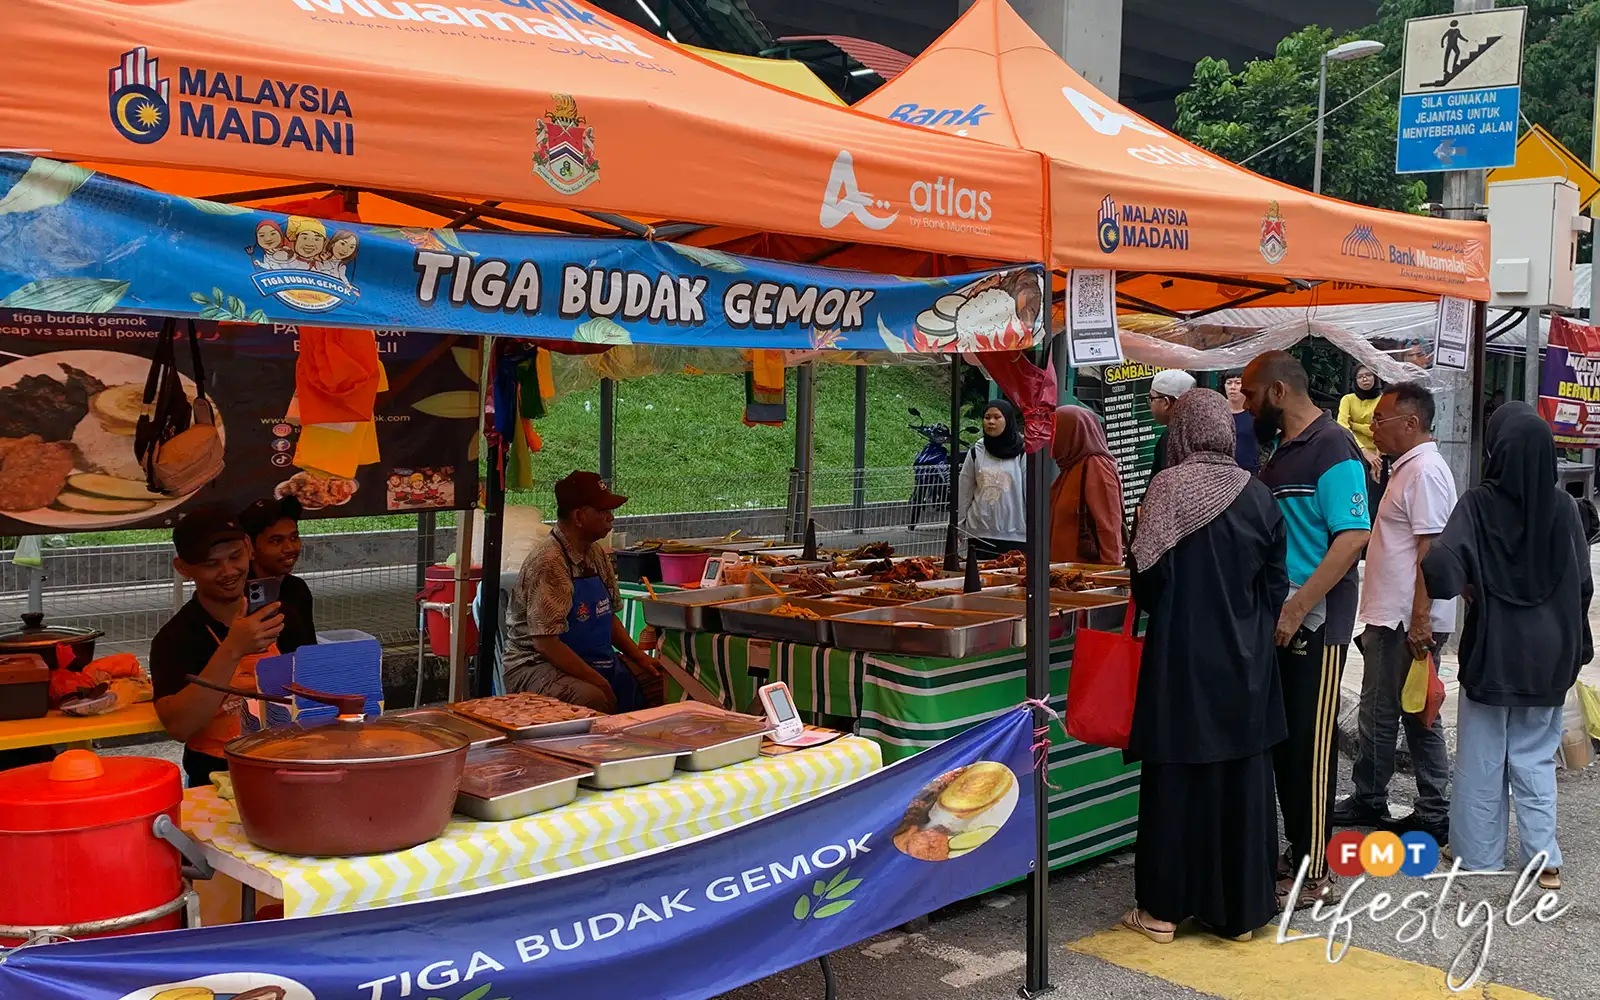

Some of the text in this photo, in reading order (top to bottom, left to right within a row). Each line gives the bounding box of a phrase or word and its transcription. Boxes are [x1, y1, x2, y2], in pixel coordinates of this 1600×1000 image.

[291, 0, 656, 60] Muamalat
[179, 65, 353, 118] MALAYSIA
[1421, 91, 1497, 109] SILA GUNAKAN
[887, 103, 995, 126] Bank
[1415, 106, 1501, 124] JEJANTAS UNTUK
[179, 100, 355, 156] MADANI
[1402, 121, 1513, 139] MENYEBERANG JALAN
[909, 176, 992, 222] atlas
[909, 215, 992, 237] by Bank Muamalat
[1122, 204, 1189, 227] MALAYSIA
[1122, 223, 1190, 252] MADANI
[260, 276, 285, 288] TIGA
[284, 275, 316, 286] BUDAK
[316, 279, 351, 297] GEMOK
[417, 250, 876, 329] TIGA BUDAK GEMOK
[12, 312, 148, 327] tiga budak gemok
[0, 326, 160, 340] ecap vs sambal power
[1106, 364, 1153, 382] SAMBAL
[358, 832, 875, 1000] TIGA BUDAK GEMOK
